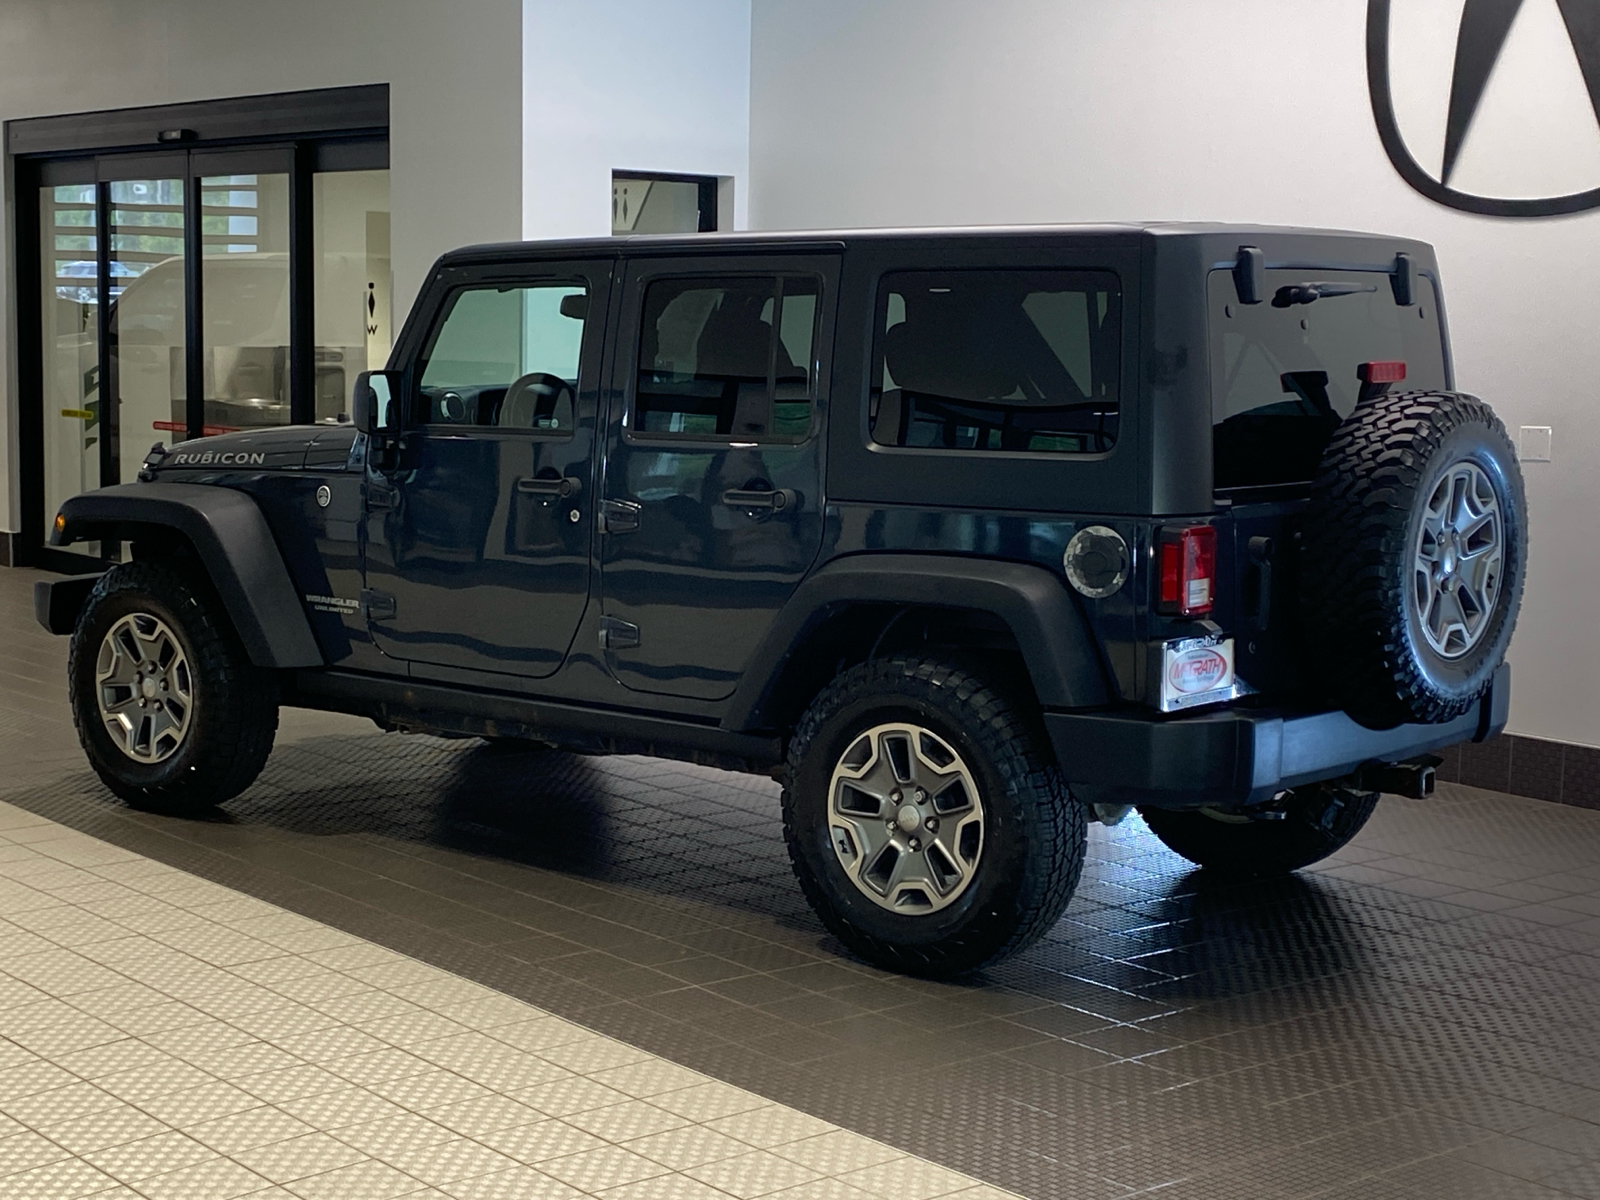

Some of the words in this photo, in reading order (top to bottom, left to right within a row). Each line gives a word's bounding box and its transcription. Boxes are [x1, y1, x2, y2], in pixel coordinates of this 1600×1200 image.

[366, 324, 378, 336] W
[174, 452, 265, 464] RUBICON
[306, 594, 359, 608] WRANGLER
